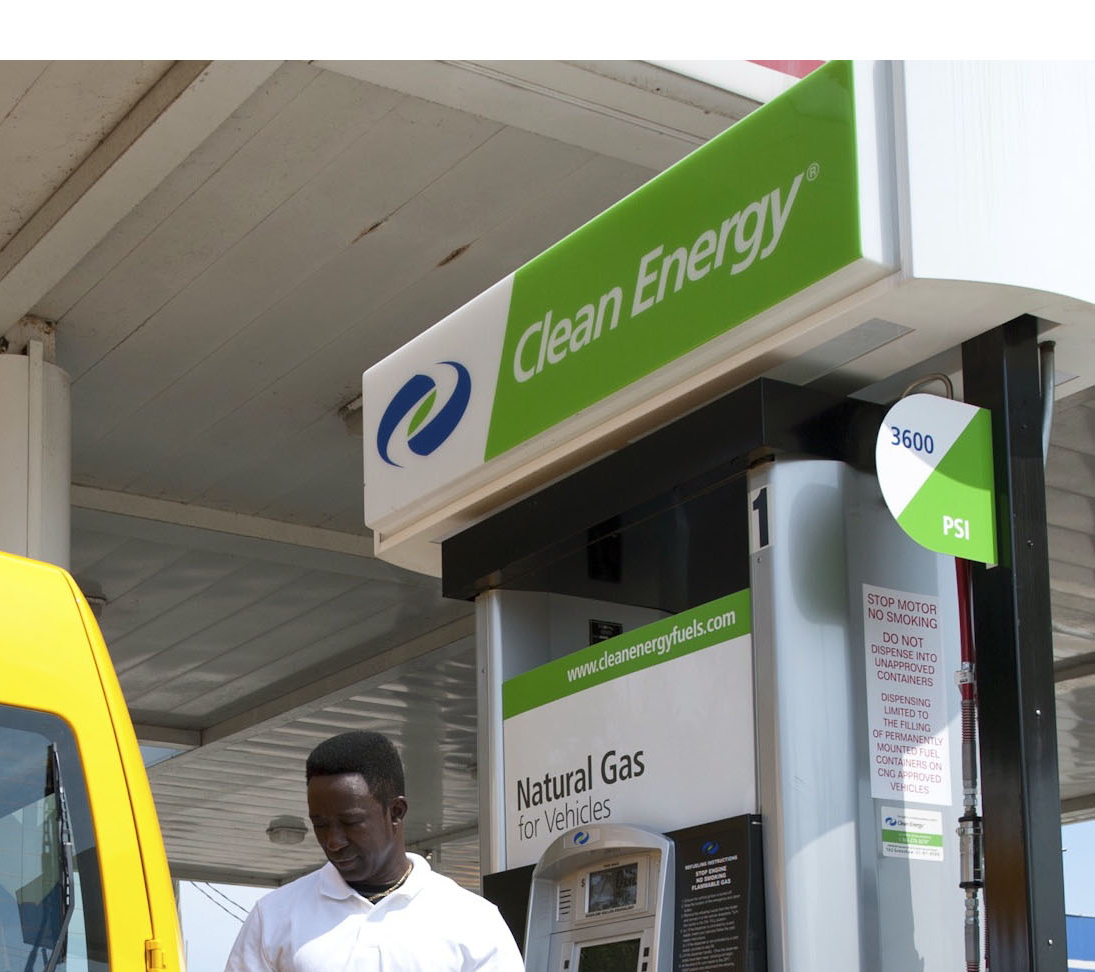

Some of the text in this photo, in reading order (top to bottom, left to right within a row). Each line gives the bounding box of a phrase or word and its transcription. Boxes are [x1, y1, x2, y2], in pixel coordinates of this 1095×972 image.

[513, 286, 623, 383] Clean
[631, 172, 805, 319] Energy
[890, 426, 935, 455] 3600
[752, 486, 770, 549] 1
[942, 515, 970, 540] PSI
[867, 593, 937, 615] STOP MOTOR
[868, 607, 938, 629] NO SMOKING
[566, 610, 736, 682] www.cleanenergyfuels.com
[882, 631, 924, 648] DO NOT
[871, 644, 937, 663] DISPENSE INTO
[874, 657, 935, 675] UNAPPROVED
[877, 670, 934, 687] CONTAINERS
[881, 693, 931, 708] DISPENSING
[884, 706, 929, 720] LIMITED TO
[883, 718, 931, 733] THE FILLING
[872, 729, 944, 746] OF PERMANENTLY
[877, 742, 941, 759] MOUNTED FUEL
[876, 755, 943, 771] CONTAINERS ON
[517, 750, 646, 811] Natural Gas
[877, 768, 942, 784] CNG APPROVED
[890, 782, 930, 795] VEHICLES
[518, 795, 612, 841] for Vehicles
[720, 878, 732, 886] GAS
